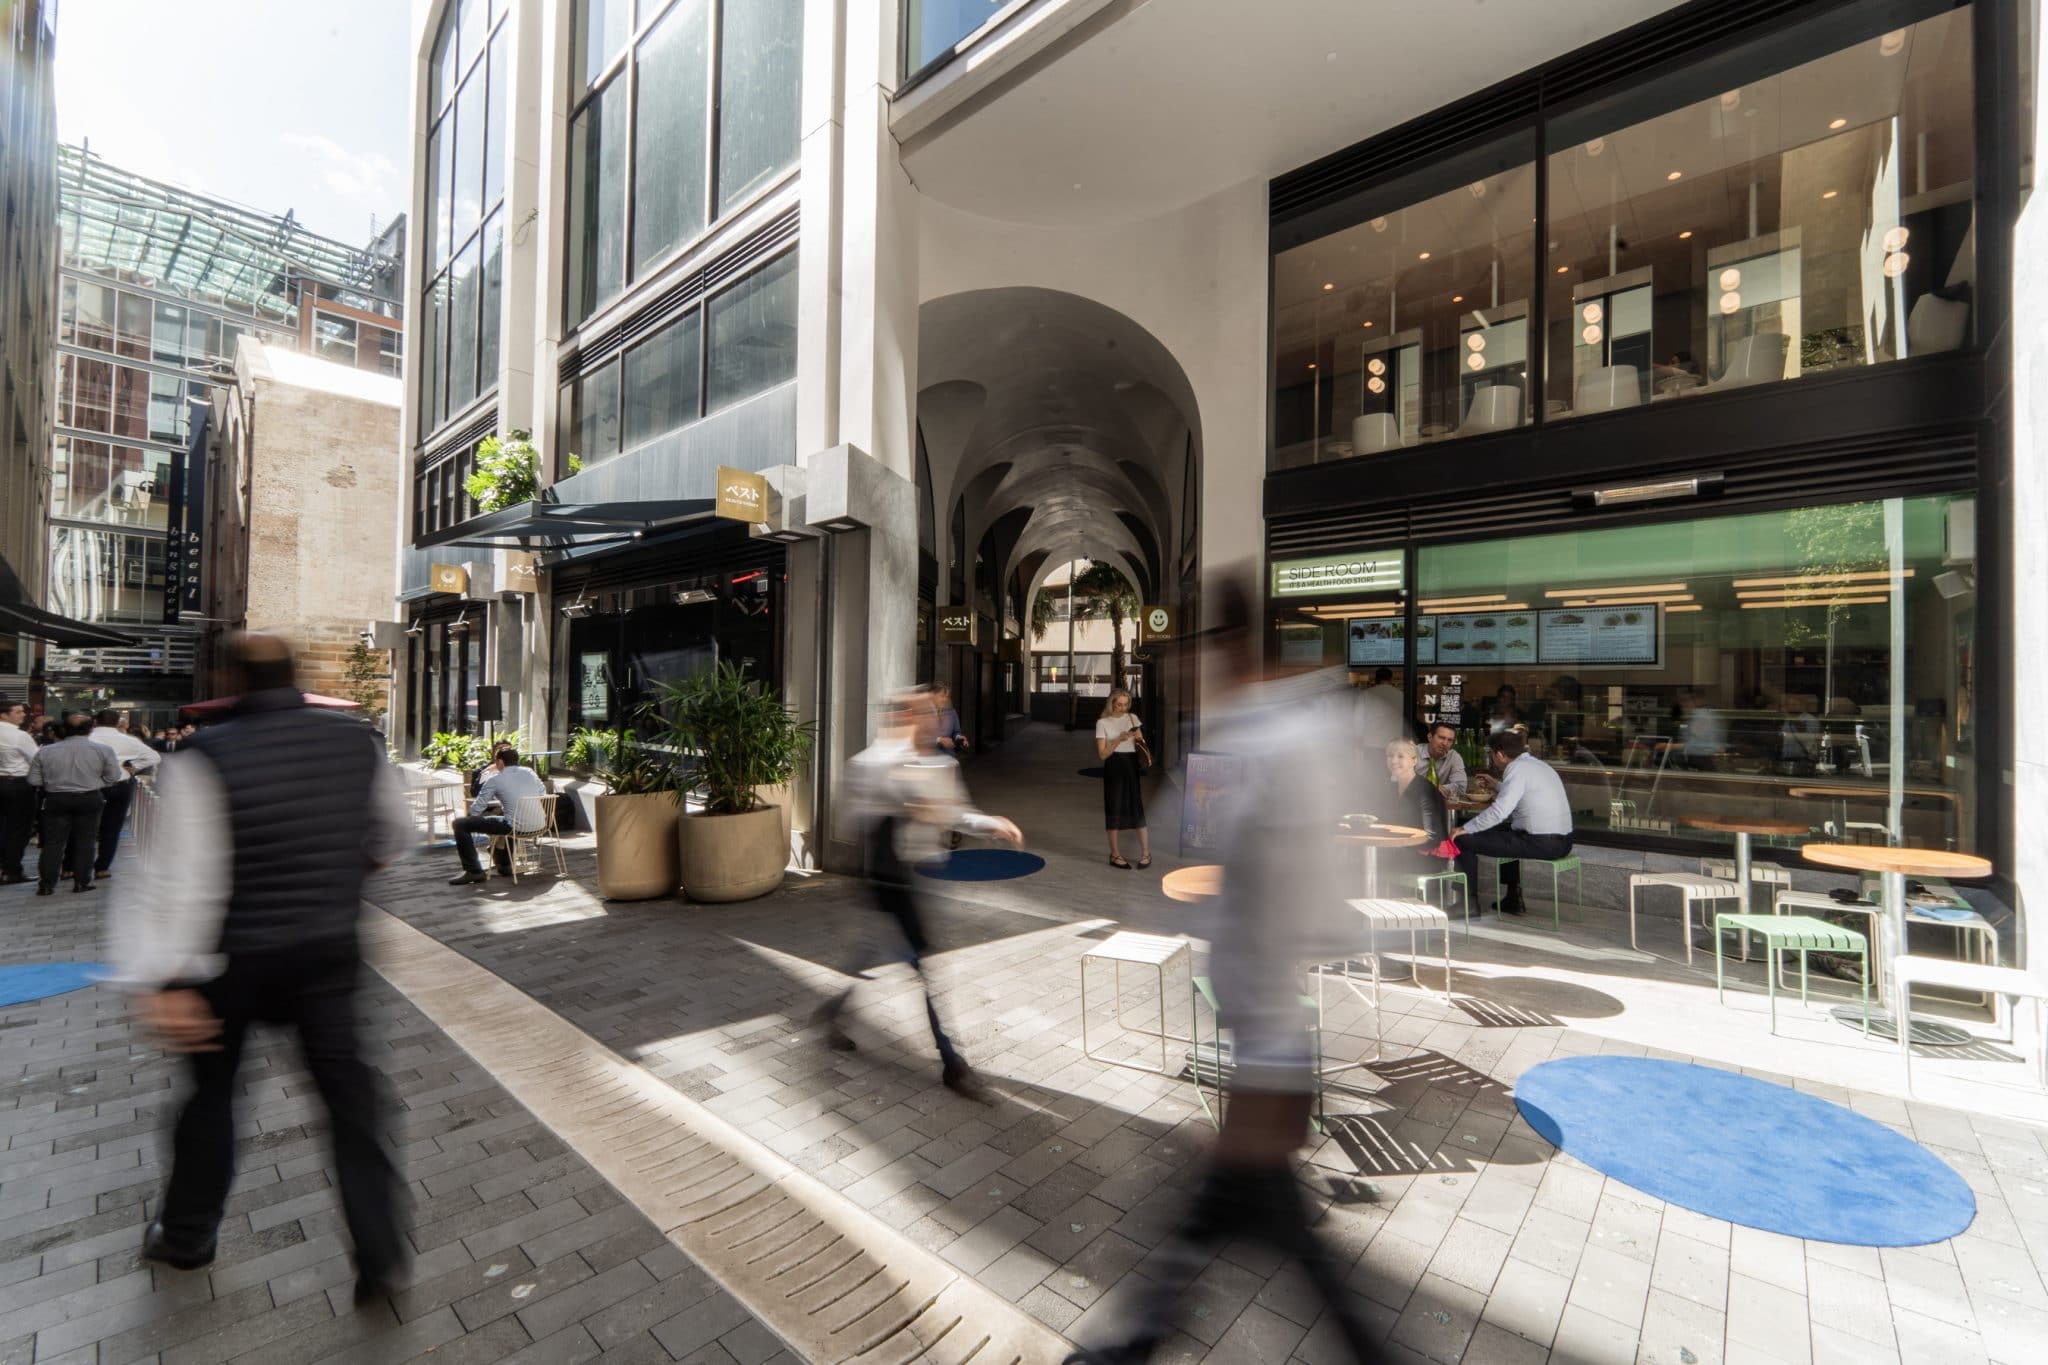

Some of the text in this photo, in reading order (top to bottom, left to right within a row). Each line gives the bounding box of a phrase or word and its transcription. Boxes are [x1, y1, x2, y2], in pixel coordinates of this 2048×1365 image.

[187, 532, 199, 599] beeal
[1288, 561, 1377, 581] SIDE ROOM
[1306, 579, 1332, 587] HEALTH
[1332, 577, 1353, 586] FOOD
[1353, 575, 1376, 584] STORE
